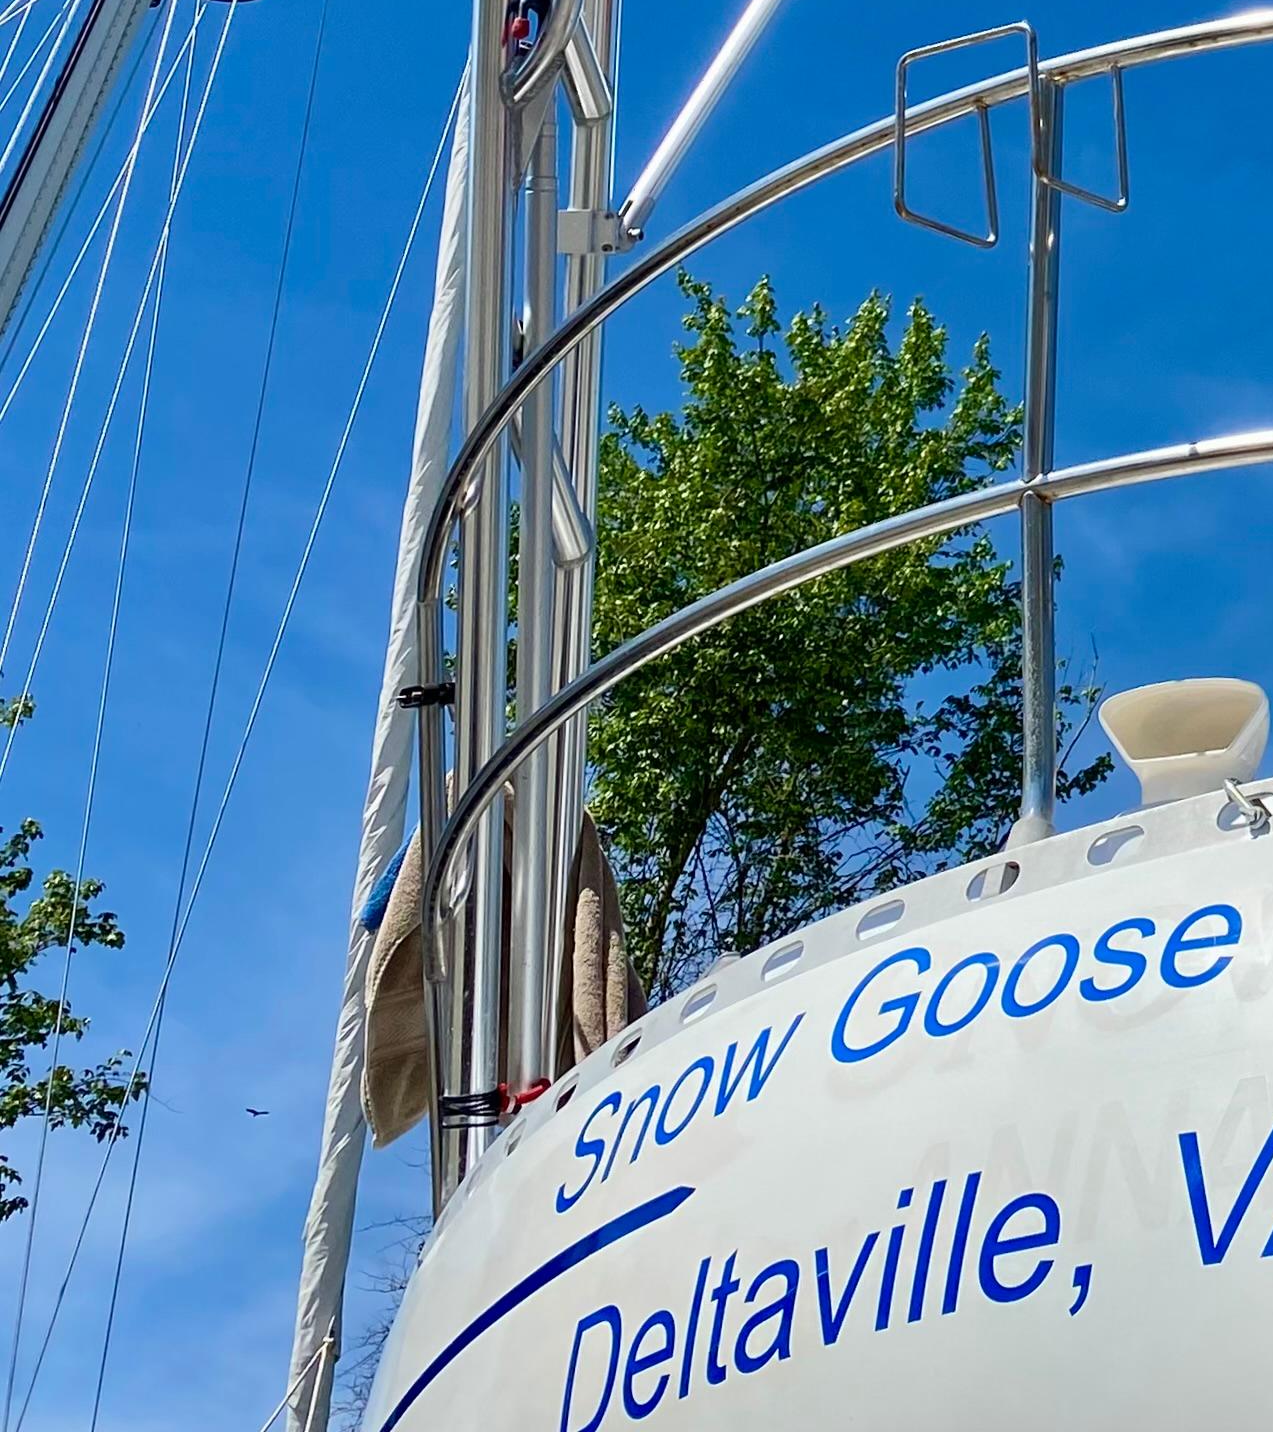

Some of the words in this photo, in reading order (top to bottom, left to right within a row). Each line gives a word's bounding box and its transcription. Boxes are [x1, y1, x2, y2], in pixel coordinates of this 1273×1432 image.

[554, 1011, 806, 1214] Snow
[830, 903, 1243, 1064] Goose
[558, 1171, 1093, 1432] Deltaville,
